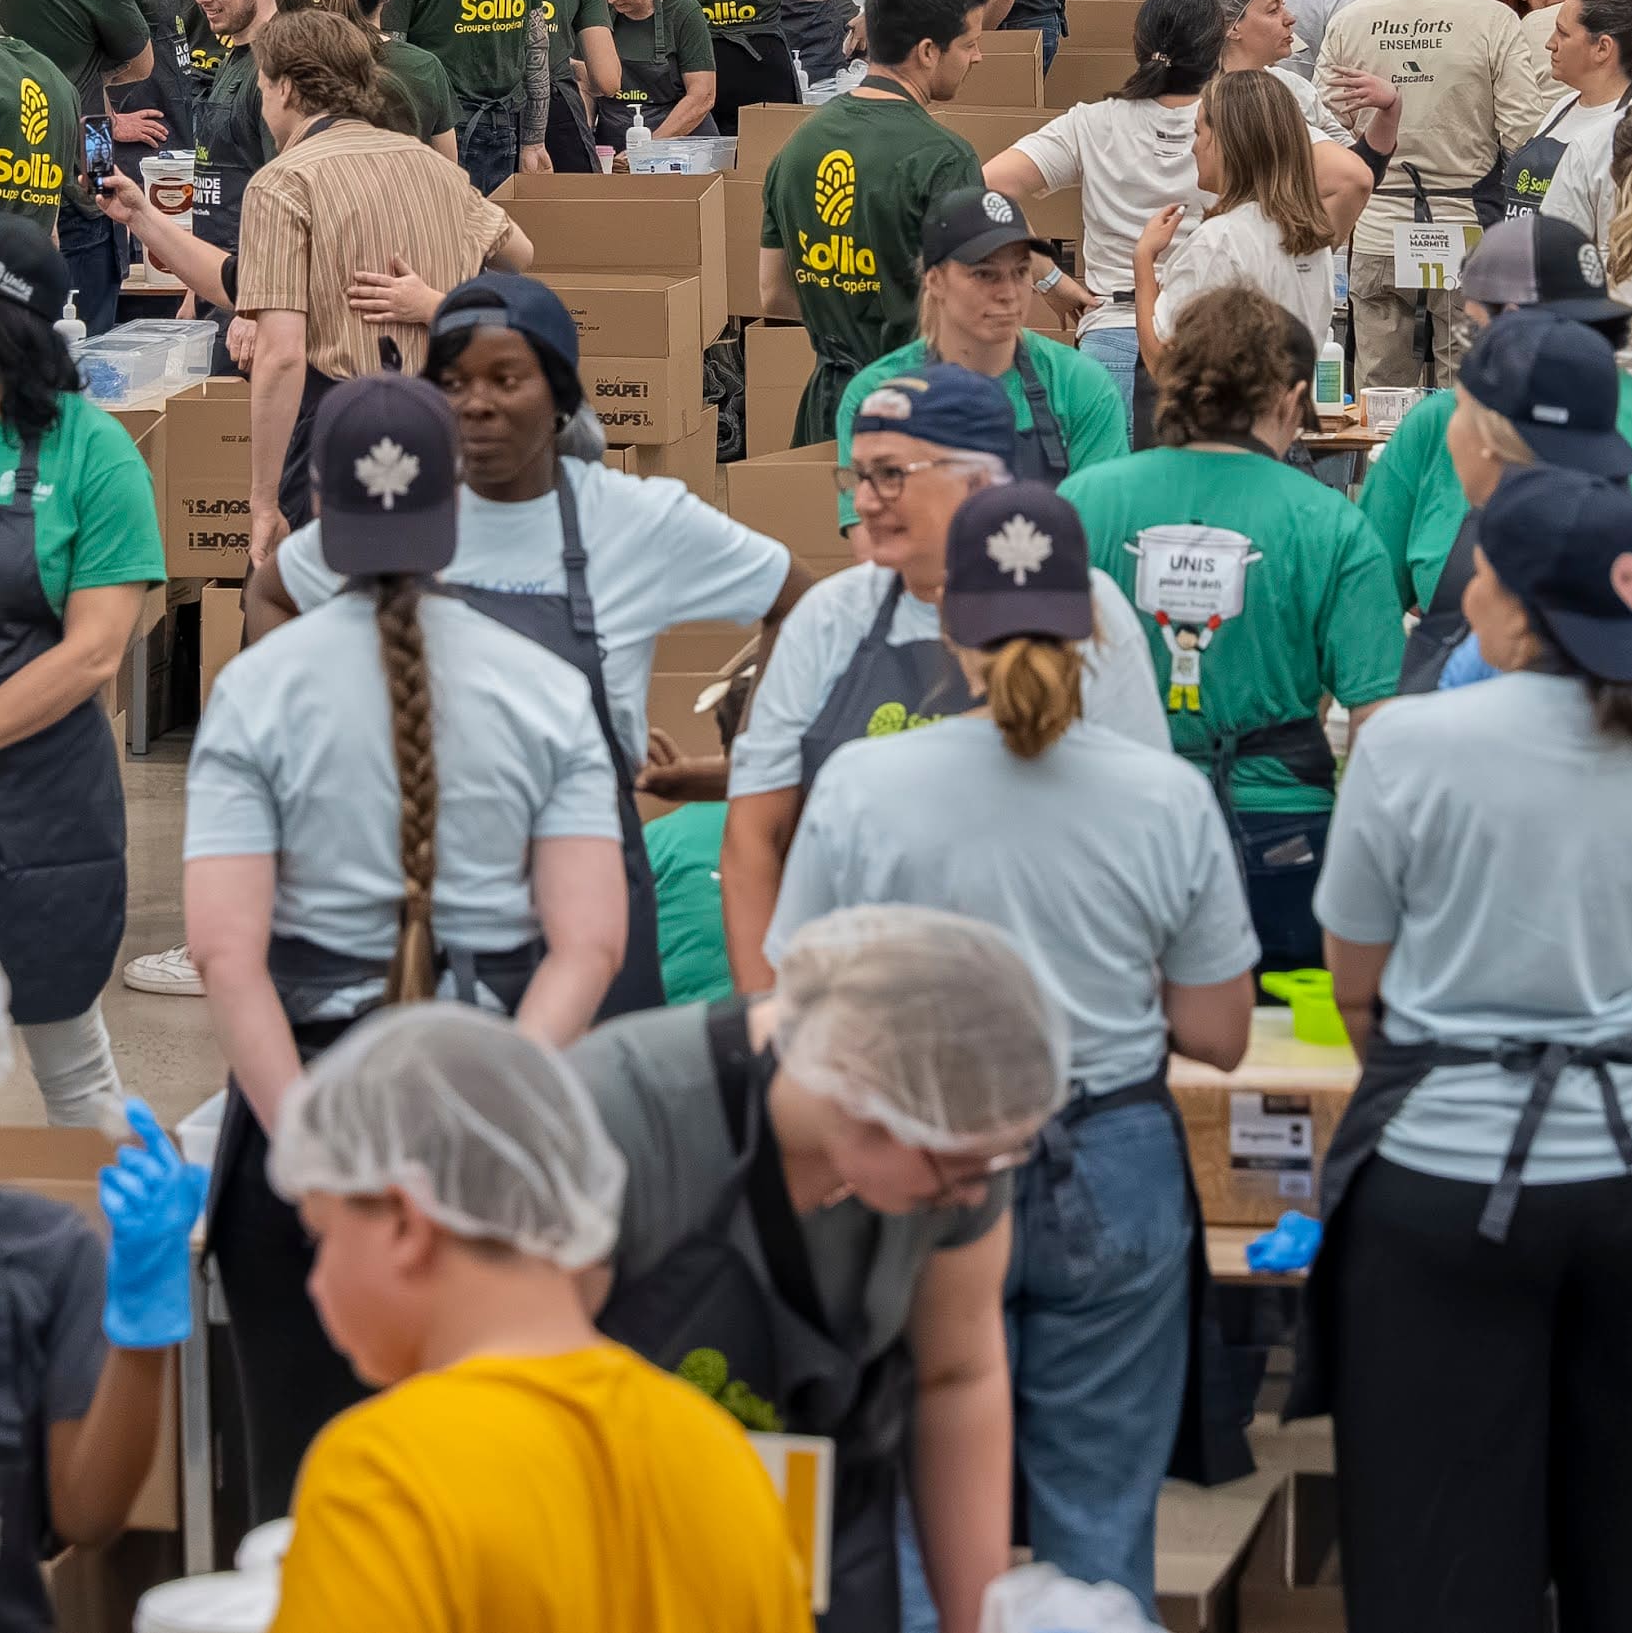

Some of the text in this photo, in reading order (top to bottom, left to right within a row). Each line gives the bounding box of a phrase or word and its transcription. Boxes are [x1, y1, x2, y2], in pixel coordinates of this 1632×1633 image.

[454, 22, 491, 35] Groupe
[1371, 18, 1454, 38] Plus forts
[1379, 38, 1443, 50] ENSEMBLE
[1390, 72, 1435, 84] Cascades
[1409, 233, 1450, 242] LA GRANDE
[1409, 241, 1450, 250] MARMITE
[1418, 262, 1445, 289] 11
[1169, 554, 1215, 573] UNIS
